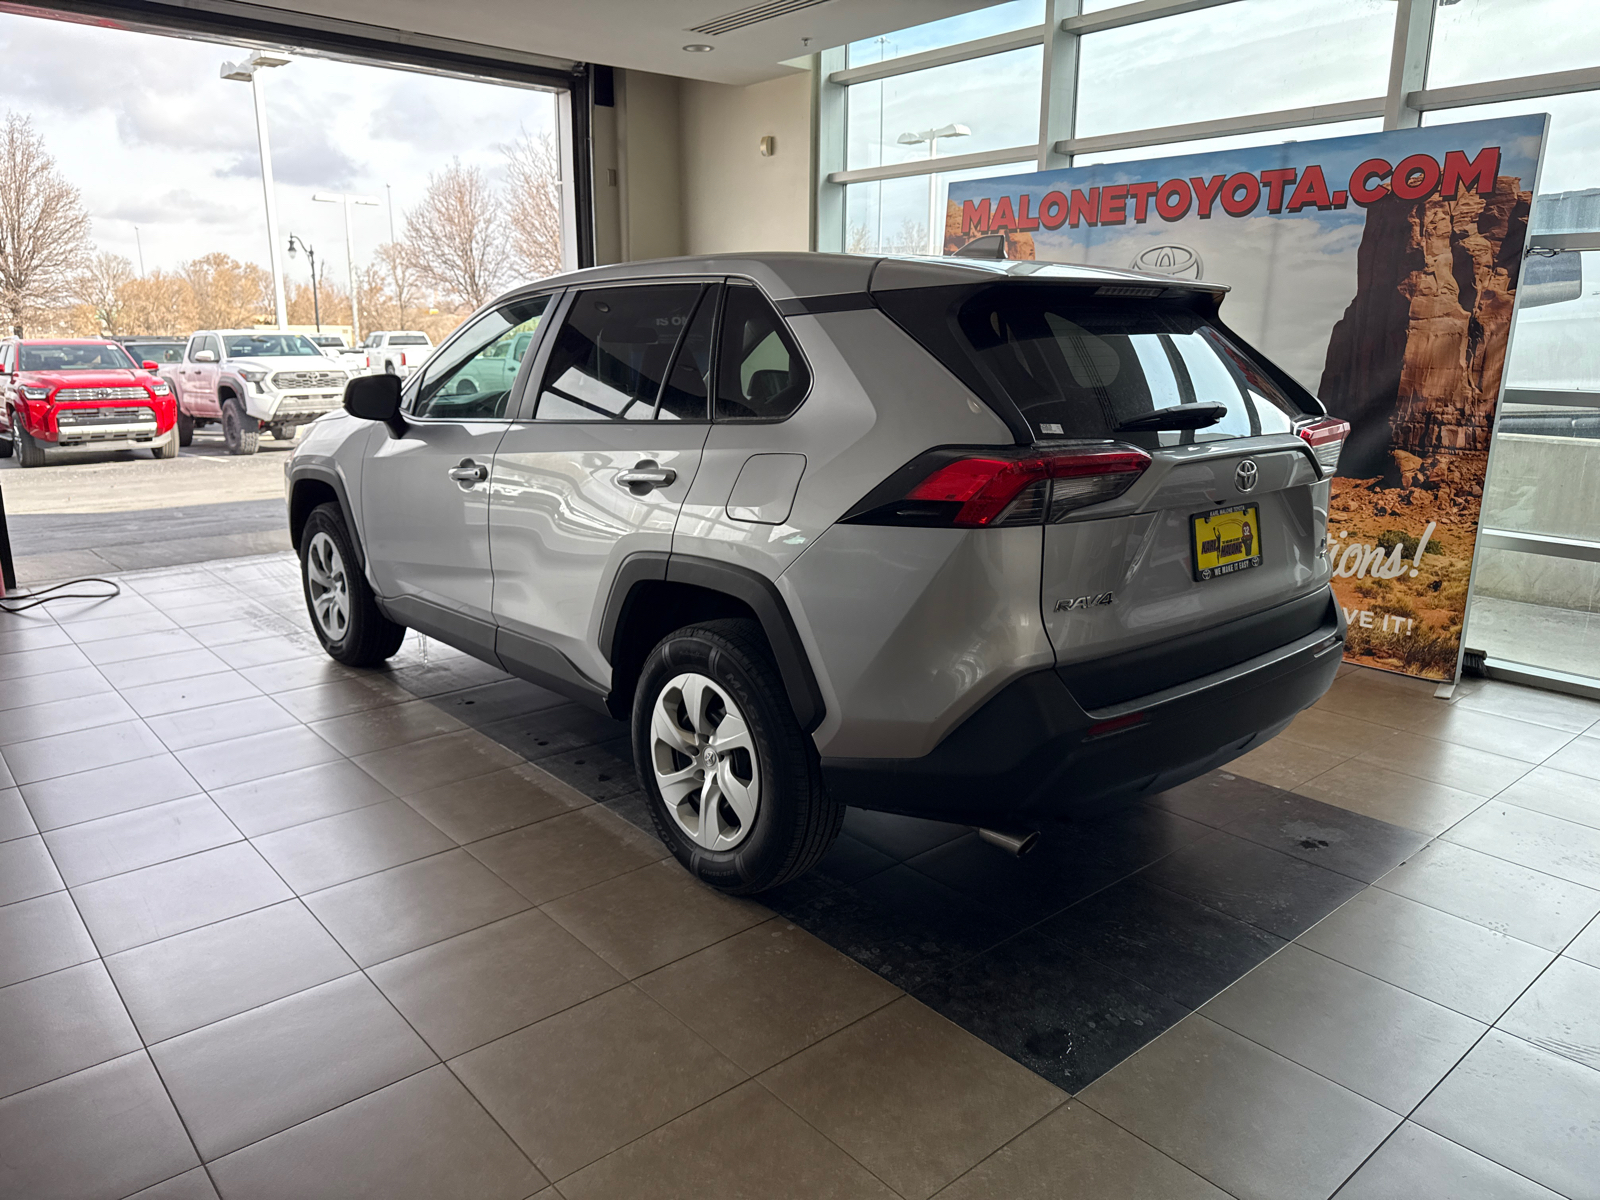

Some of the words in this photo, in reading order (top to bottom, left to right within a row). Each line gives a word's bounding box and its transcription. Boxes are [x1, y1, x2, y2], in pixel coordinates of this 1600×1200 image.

[960, 145, 1501, 237] MALONETOYOTA.COM
[1222, 564, 1234, 574] MAKE
[1238, 560, 1248, 570] EASY
[1053, 590, 1113, 613] RAV4
[1382, 614, 1413, 636] IT!
